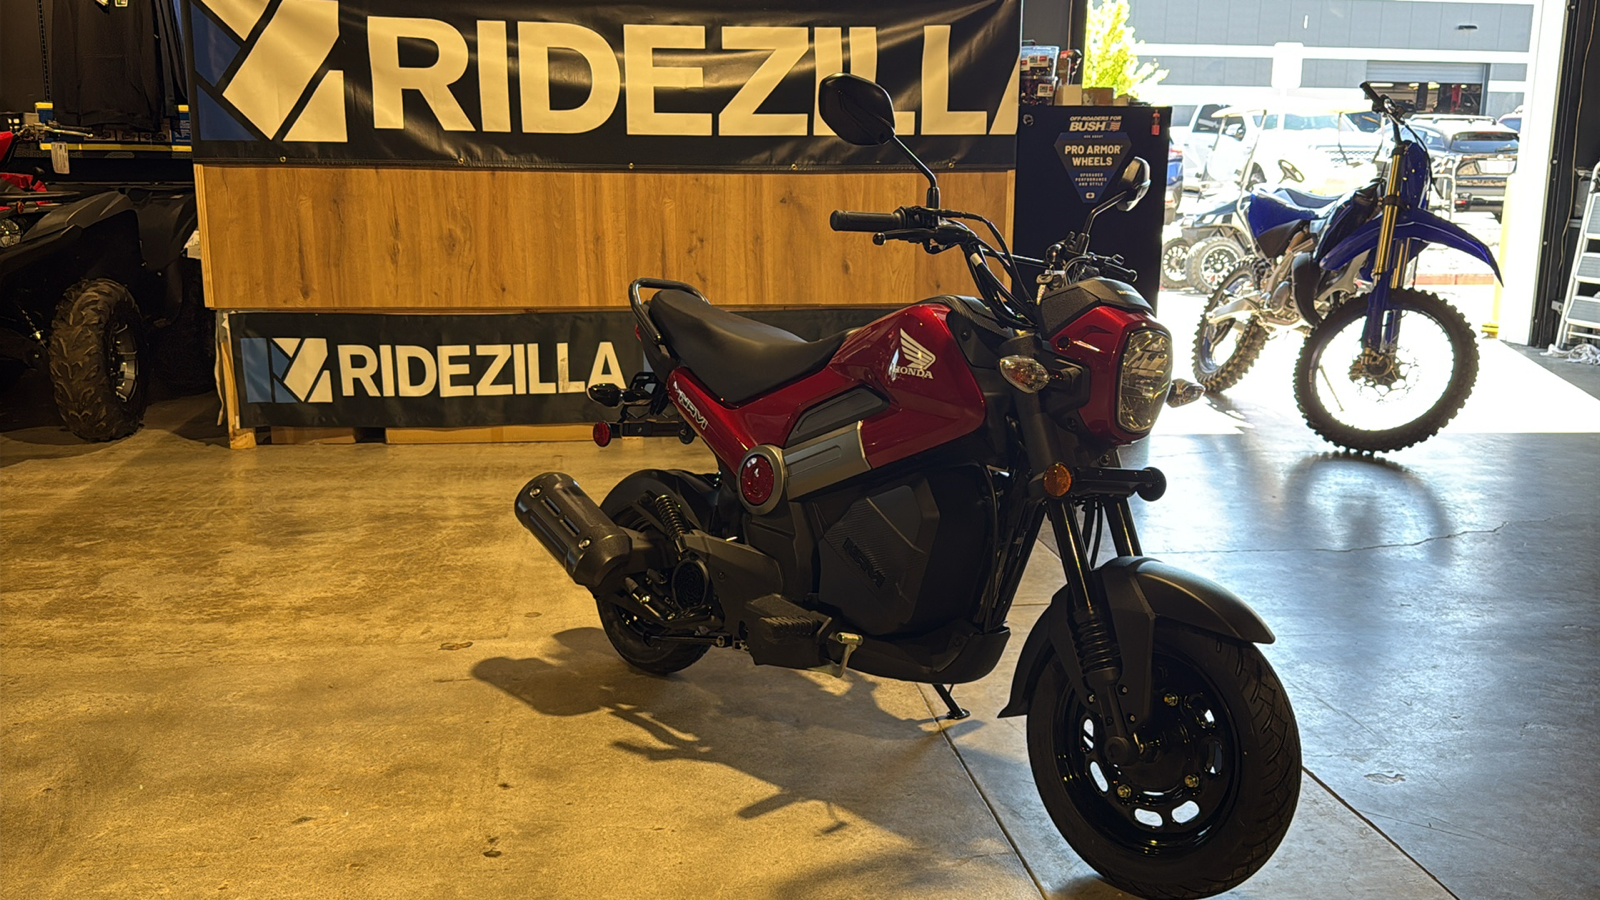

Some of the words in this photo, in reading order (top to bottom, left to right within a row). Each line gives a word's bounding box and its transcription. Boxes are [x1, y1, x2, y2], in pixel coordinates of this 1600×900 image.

[1069, 121, 1106, 132] BUSH
[1064, 144, 1085, 155] PRO
[1086, 144, 1121, 155] ARMOR
[1072, 156, 1113, 167] WHEELS
[337, 341, 627, 398] RIDEZILLA
[893, 365, 934, 379] HONDA
